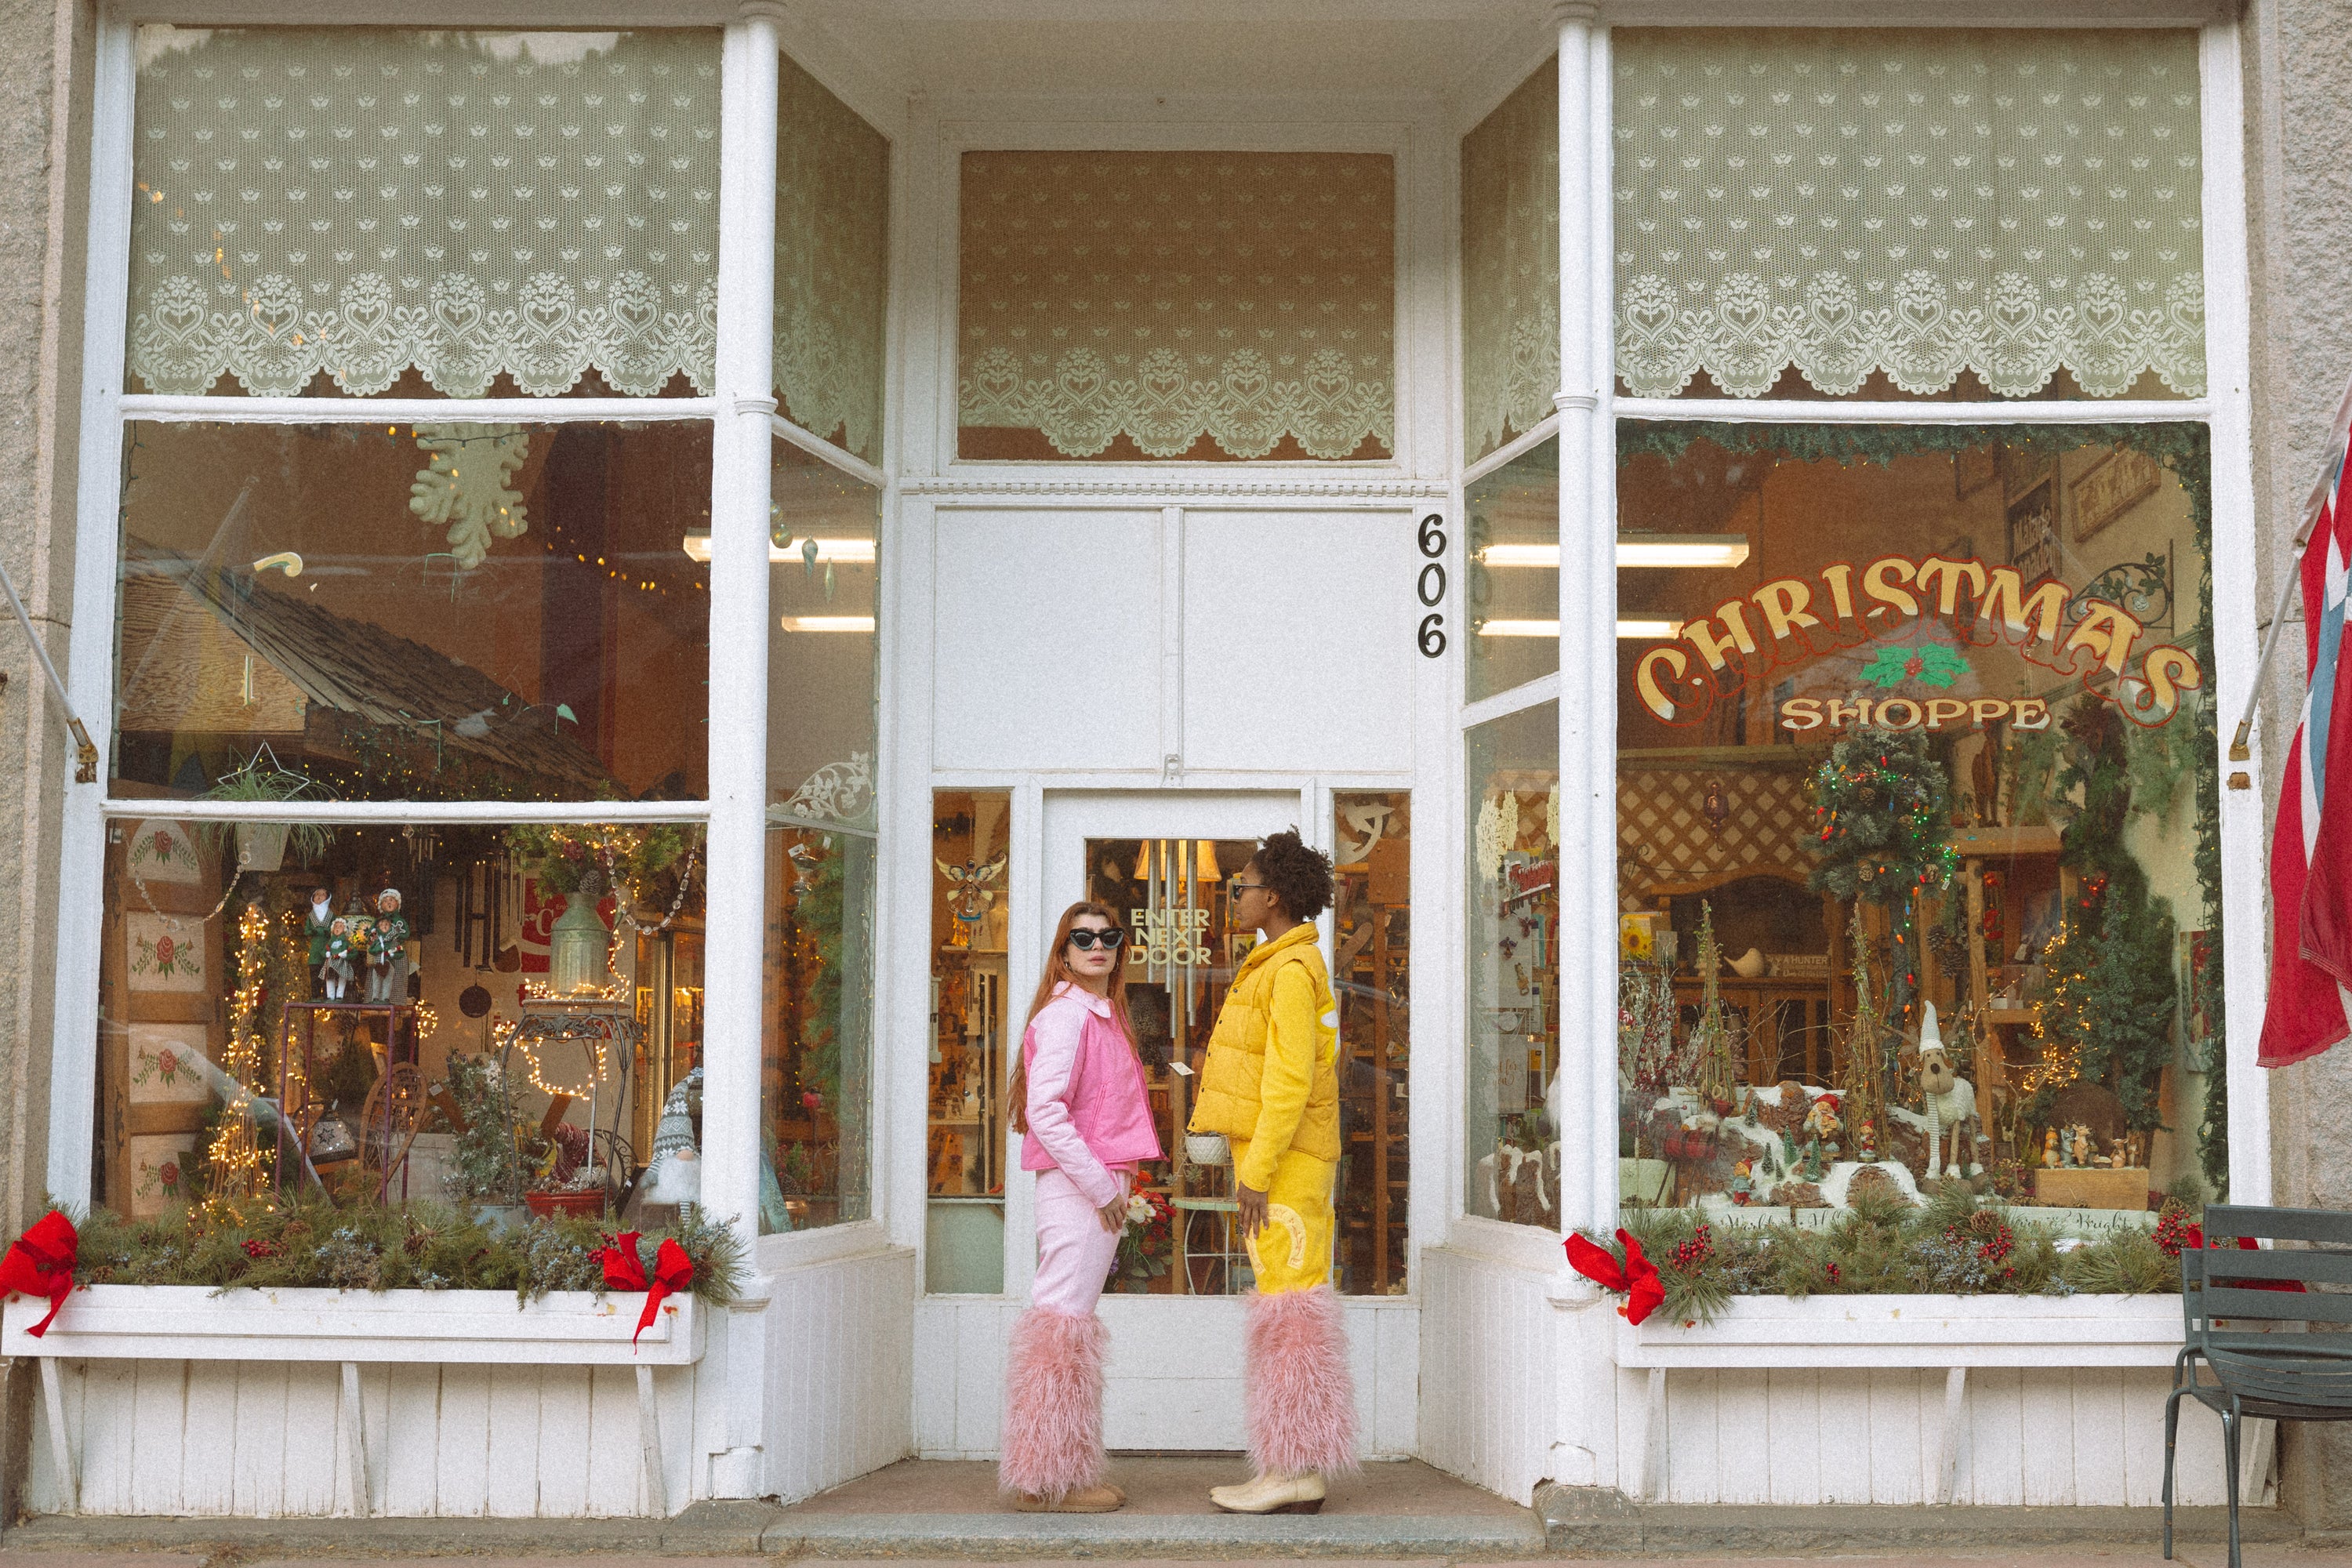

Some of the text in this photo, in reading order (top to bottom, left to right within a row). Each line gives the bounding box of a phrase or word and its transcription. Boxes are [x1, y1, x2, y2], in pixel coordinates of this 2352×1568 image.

[1417, 514, 1446, 658] 606
[1634, 556, 2202, 728] CHRISTMAS
[1781, 696, 2051, 731] SHOPPE
[1131, 909, 1210, 926] ENTER
[1135, 927, 1207, 946] NEXT
[1129, 946, 1212, 965] DOOR
[1791, 956, 1828, 964] HUNTER
